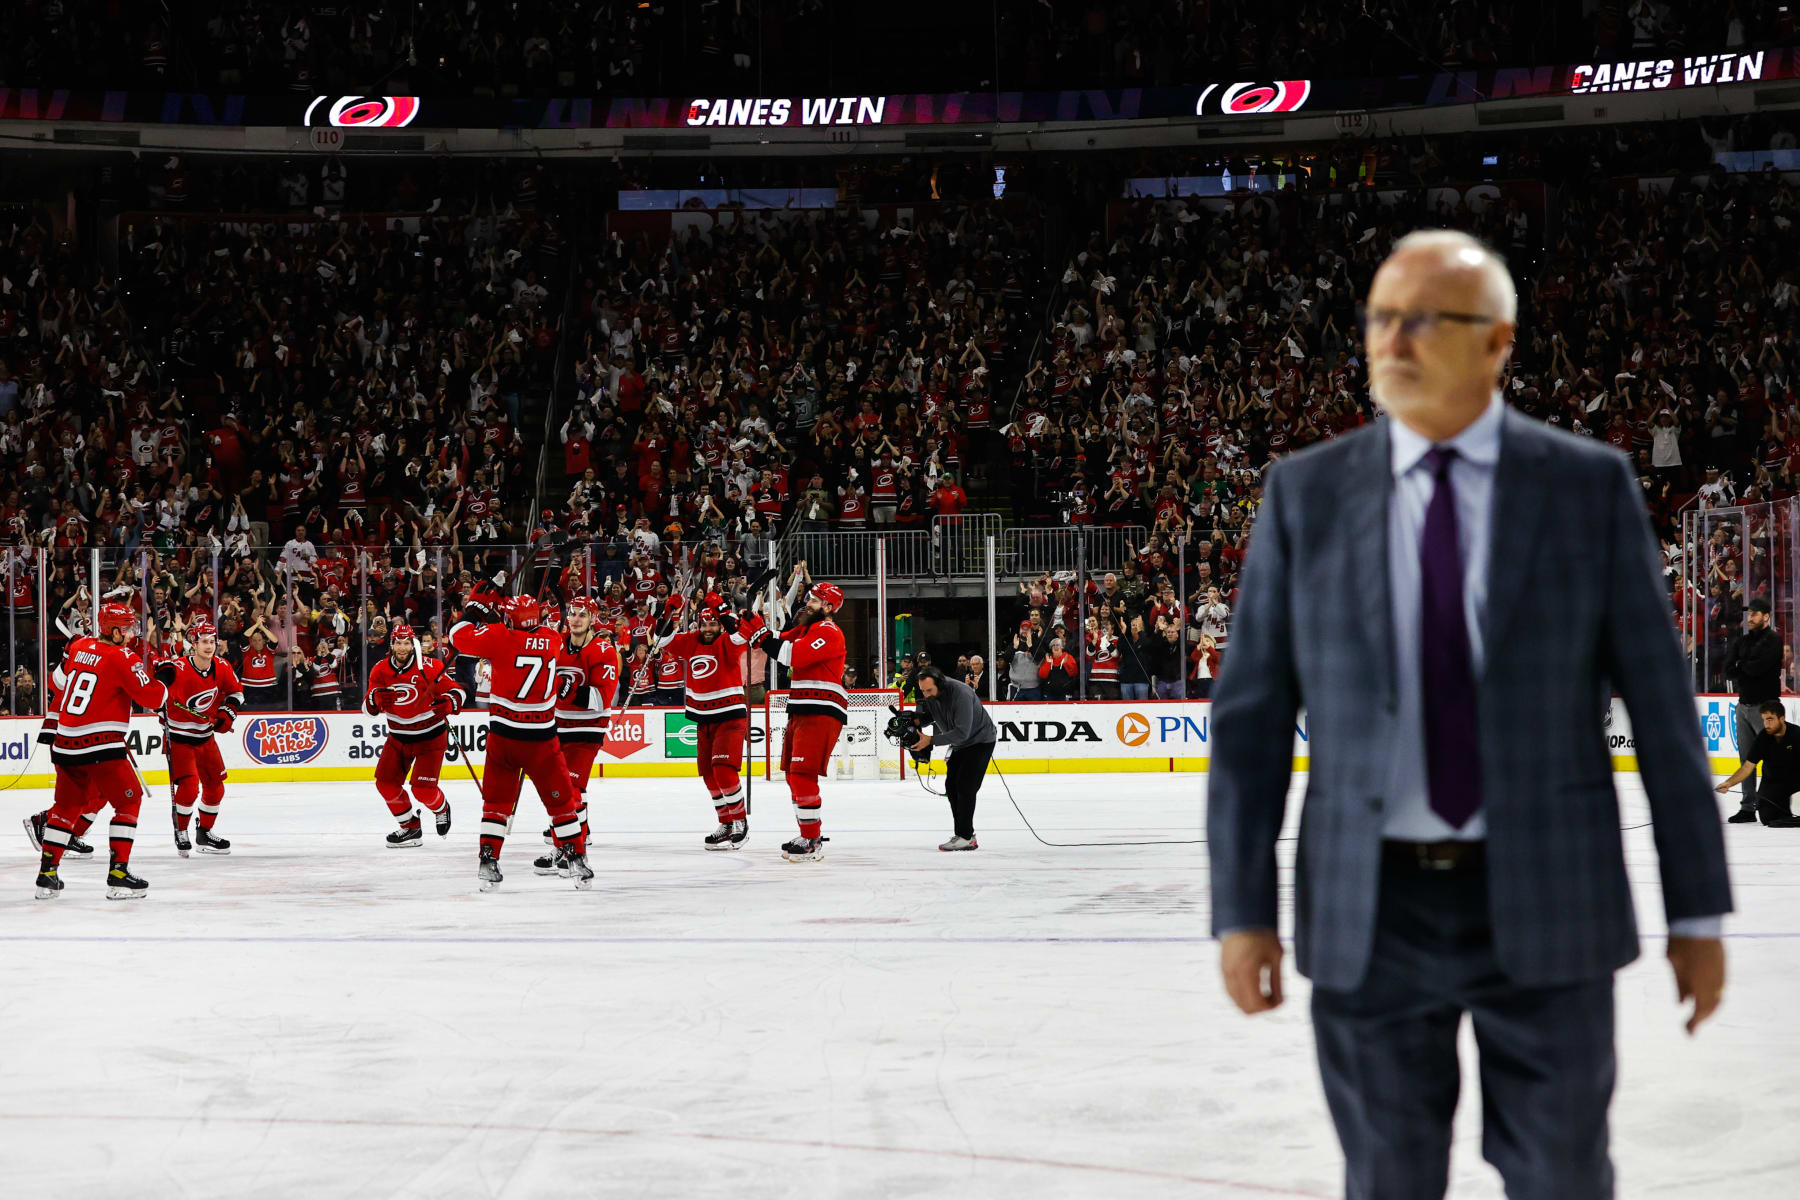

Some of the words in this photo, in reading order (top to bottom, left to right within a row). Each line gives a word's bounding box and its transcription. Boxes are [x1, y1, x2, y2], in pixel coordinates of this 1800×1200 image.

[1571, 60, 1675, 94] CANES
[1684, 51, 1765, 86] WIN
[686, 97, 792, 126] CANES
[802, 96, 886, 125] WIN
[1342, 114, 1361, 127] 112
[317, 131, 338, 144] 110
[832, 131, 850, 144] 111
[525, 637, 550, 651] FAST
[810, 637, 826, 650] 8
[74, 650, 102, 668] DRURY
[135, 669, 150, 687] 18
[410, 674, 419, 684] C
[515, 655, 557, 699] 71
[602, 664, 616, 680] 76
[59, 669, 98, 716] 18
[255, 720, 315, 738] Jersey
[352, 724, 364, 738] a
[605, 718, 642, 742] Rate
[997, 721, 1103, 742] NDA
[1156, 716, 1207, 743] PN
[260, 734, 316, 757] Mike's
[277, 754, 301, 763] SUBS
